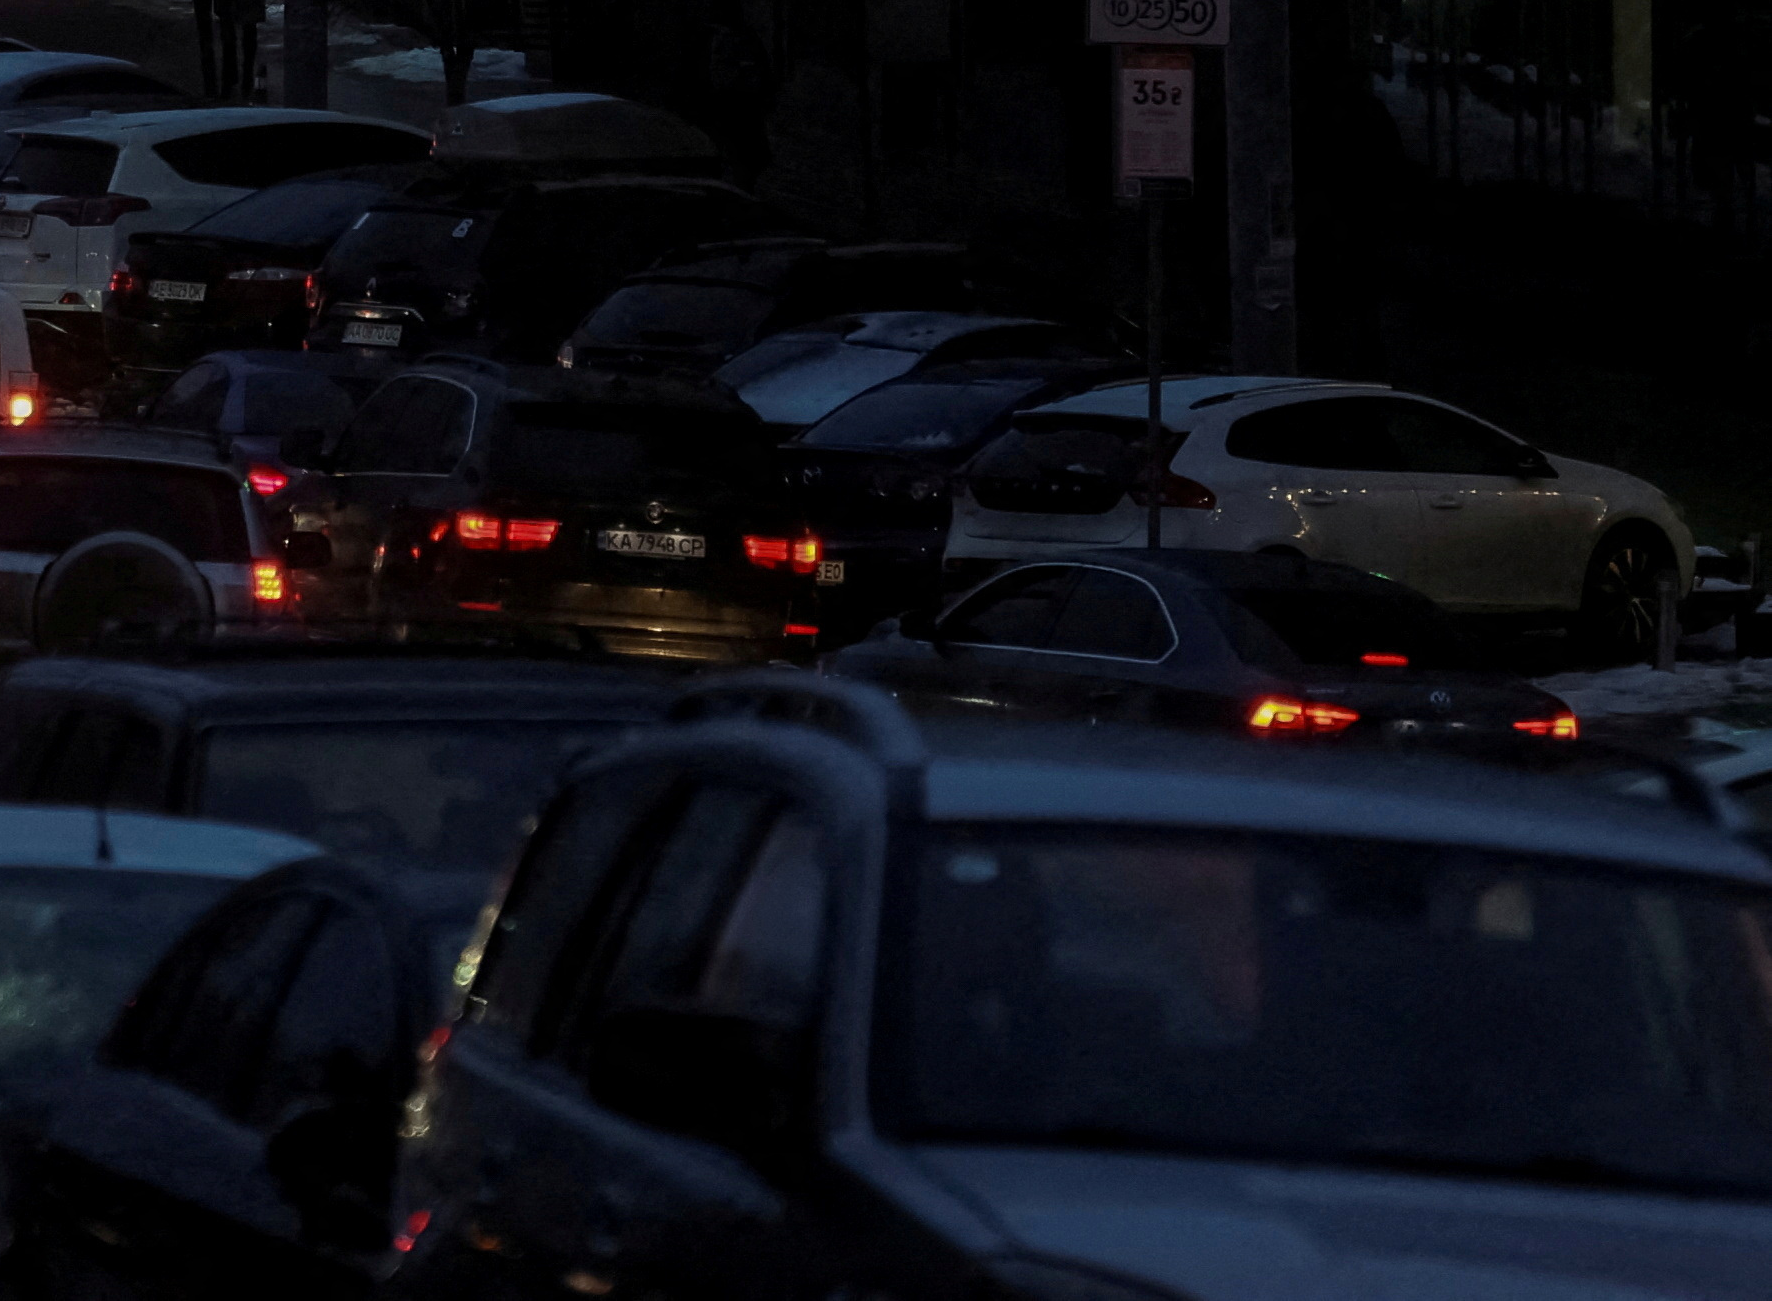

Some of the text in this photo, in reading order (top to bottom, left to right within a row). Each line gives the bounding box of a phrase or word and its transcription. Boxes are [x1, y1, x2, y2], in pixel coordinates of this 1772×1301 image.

[607, 531, 706, 557] KA 7948 CP
